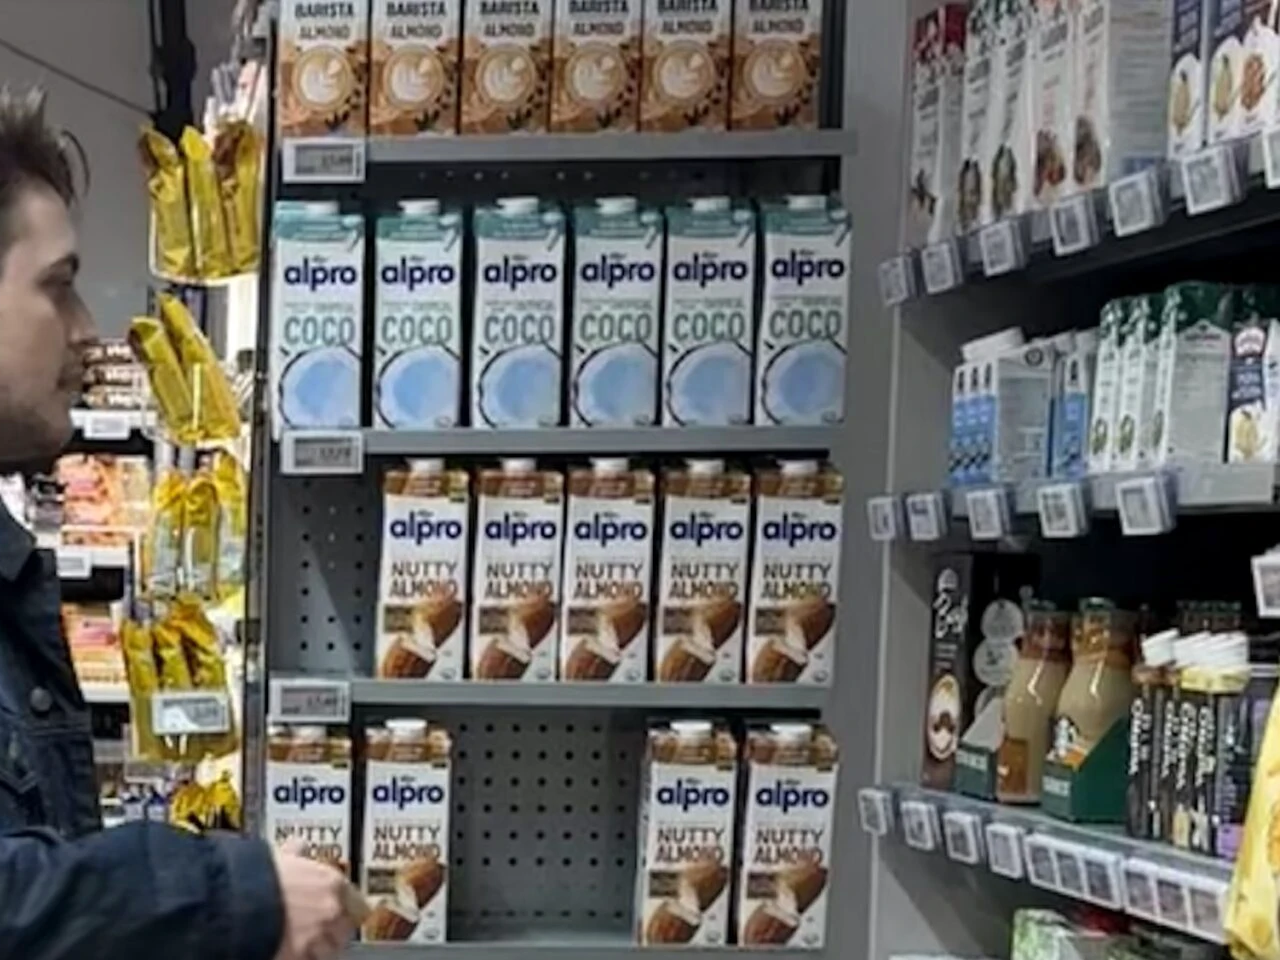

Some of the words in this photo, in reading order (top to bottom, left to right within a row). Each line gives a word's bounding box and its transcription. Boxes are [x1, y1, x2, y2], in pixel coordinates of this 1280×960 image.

[284, 257, 357, 291] alpro
[381, 256, 455, 291] alpro
[483, 256, 557, 291] alpro
[580, 254, 656, 288] alpro
[672, 253, 748, 288] alpro
[772, 251, 845, 285] alpro
[284, 315, 355, 345] COCO
[381, 315, 453, 344] COCO
[484, 314, 556, 344] COCO
[580, 313, 652, 341] COCO
[673, 312, 745, 341] COCO
[771, 310, 842, 339] COCO
[390, 511, 462, 546] alpro
[485, 512, 557, 546] alpro
[574, 513, 648, 547] alpro
[670, 512, 744, 547] alpro
[763, 512, 837, 547] alpro
[391, 561, 458, 578] NUTTY
[486, 562, 554, 579] NUTTY
[576, 563, 644, 579] NUTTY
[670, 563, 740, 579] NUTTY
[763, 563, 832, 579] NUTTY
[389, 579, 458, 598] ALMOND
[485, 580, 553, 598] ALMOND
[574, 580, 643, 599] ALMOND
[669, 581, 739, 599] ALMOND
[761, 581, 832, 599] ALMOND
[274, 777, 346, 811] alpro
[373, 776, 445, 810] alpro
[657, 778, 730, 812] alpro
[755, 779, 830, 814] alpro
[374, 825, 441, 841] NUTTY
[657, 827, 725, 844] NUTTY
[755, 828, 823, 845] NUTTY
[372, 843, 442, 861] ALMOND
[655, 846, 725, 864] ALMOND
[753, 847, 823, 865] ALMOND
